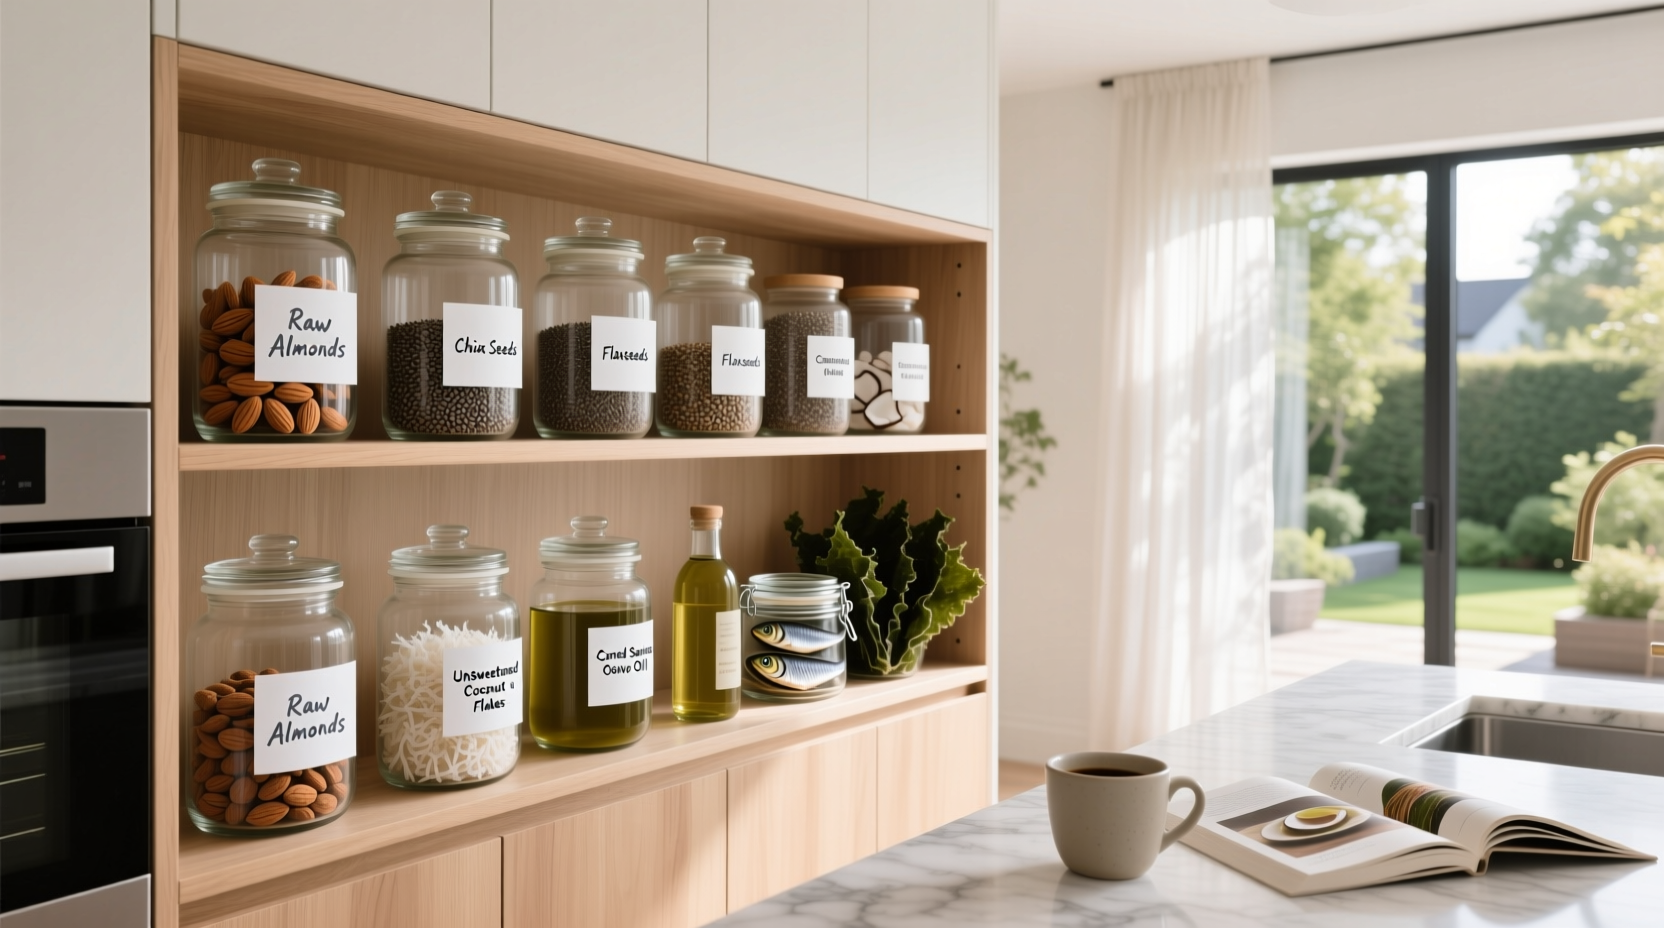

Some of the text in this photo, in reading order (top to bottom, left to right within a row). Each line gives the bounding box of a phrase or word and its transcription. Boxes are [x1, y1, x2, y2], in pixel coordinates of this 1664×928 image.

[288, 307, 332, 333] Raw
[268, 333, 346, 358] Almonds
[286, 693, 330, 717] Raw
[267, 711, 345, 747] Almonds
